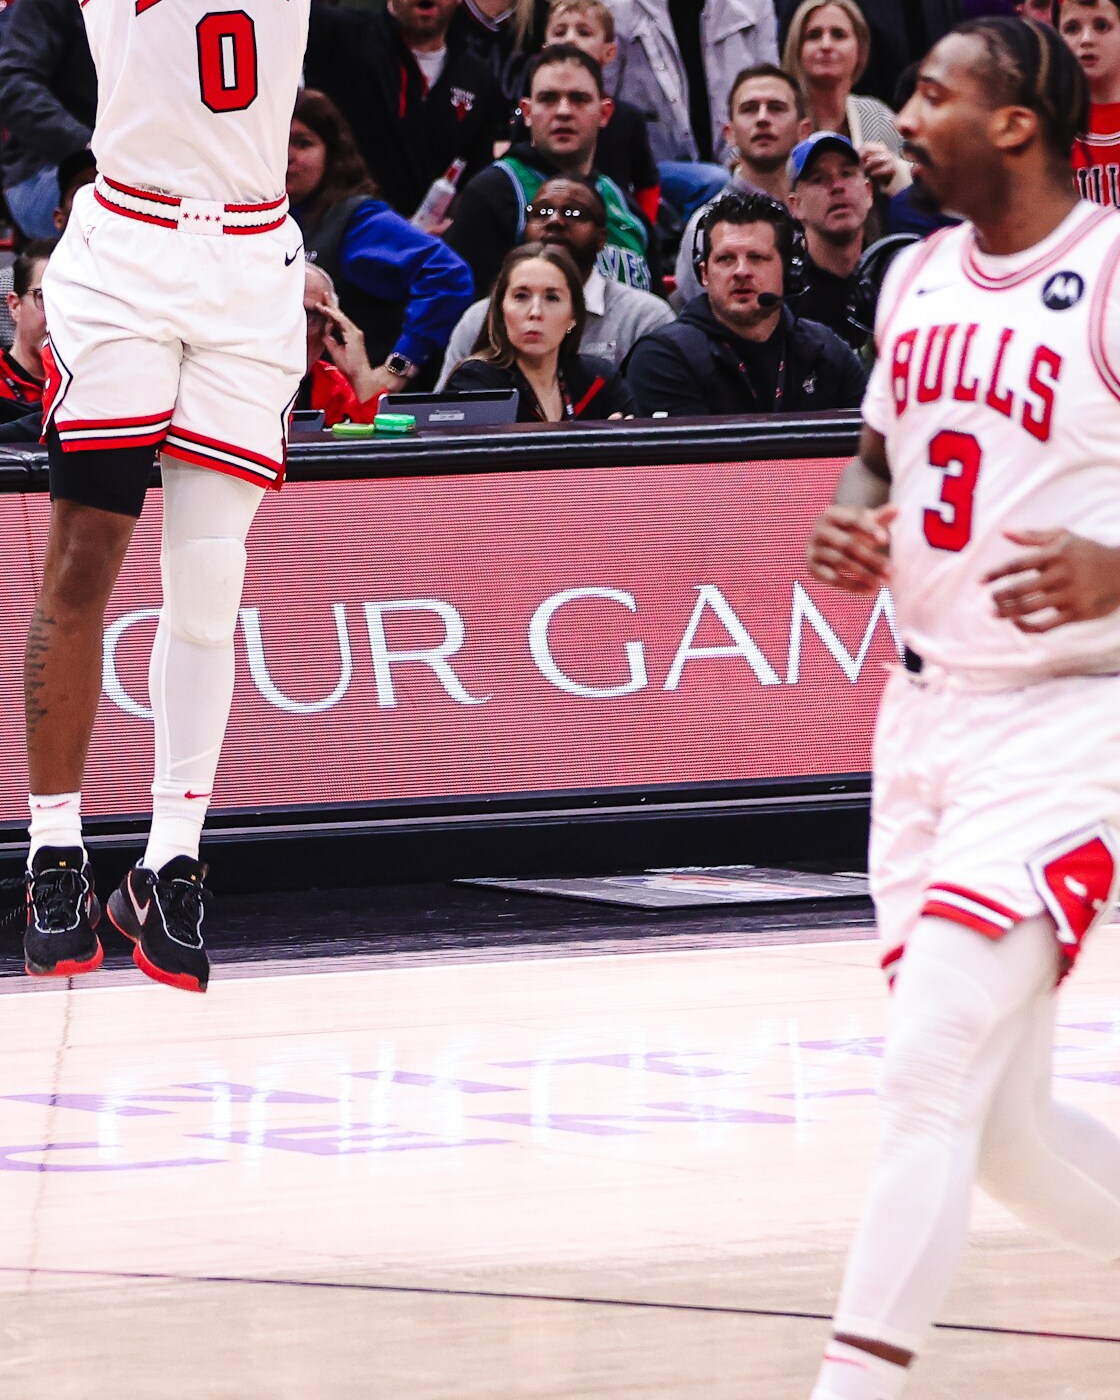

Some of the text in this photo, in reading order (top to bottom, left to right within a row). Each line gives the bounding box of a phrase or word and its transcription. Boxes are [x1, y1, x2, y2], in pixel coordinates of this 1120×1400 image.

[196, 9, 258, 114] 0
[891, 321, 1063, 443] BULLS
[923, 429, 983, 553] 3
[528, 579, 907, 700] GAM
